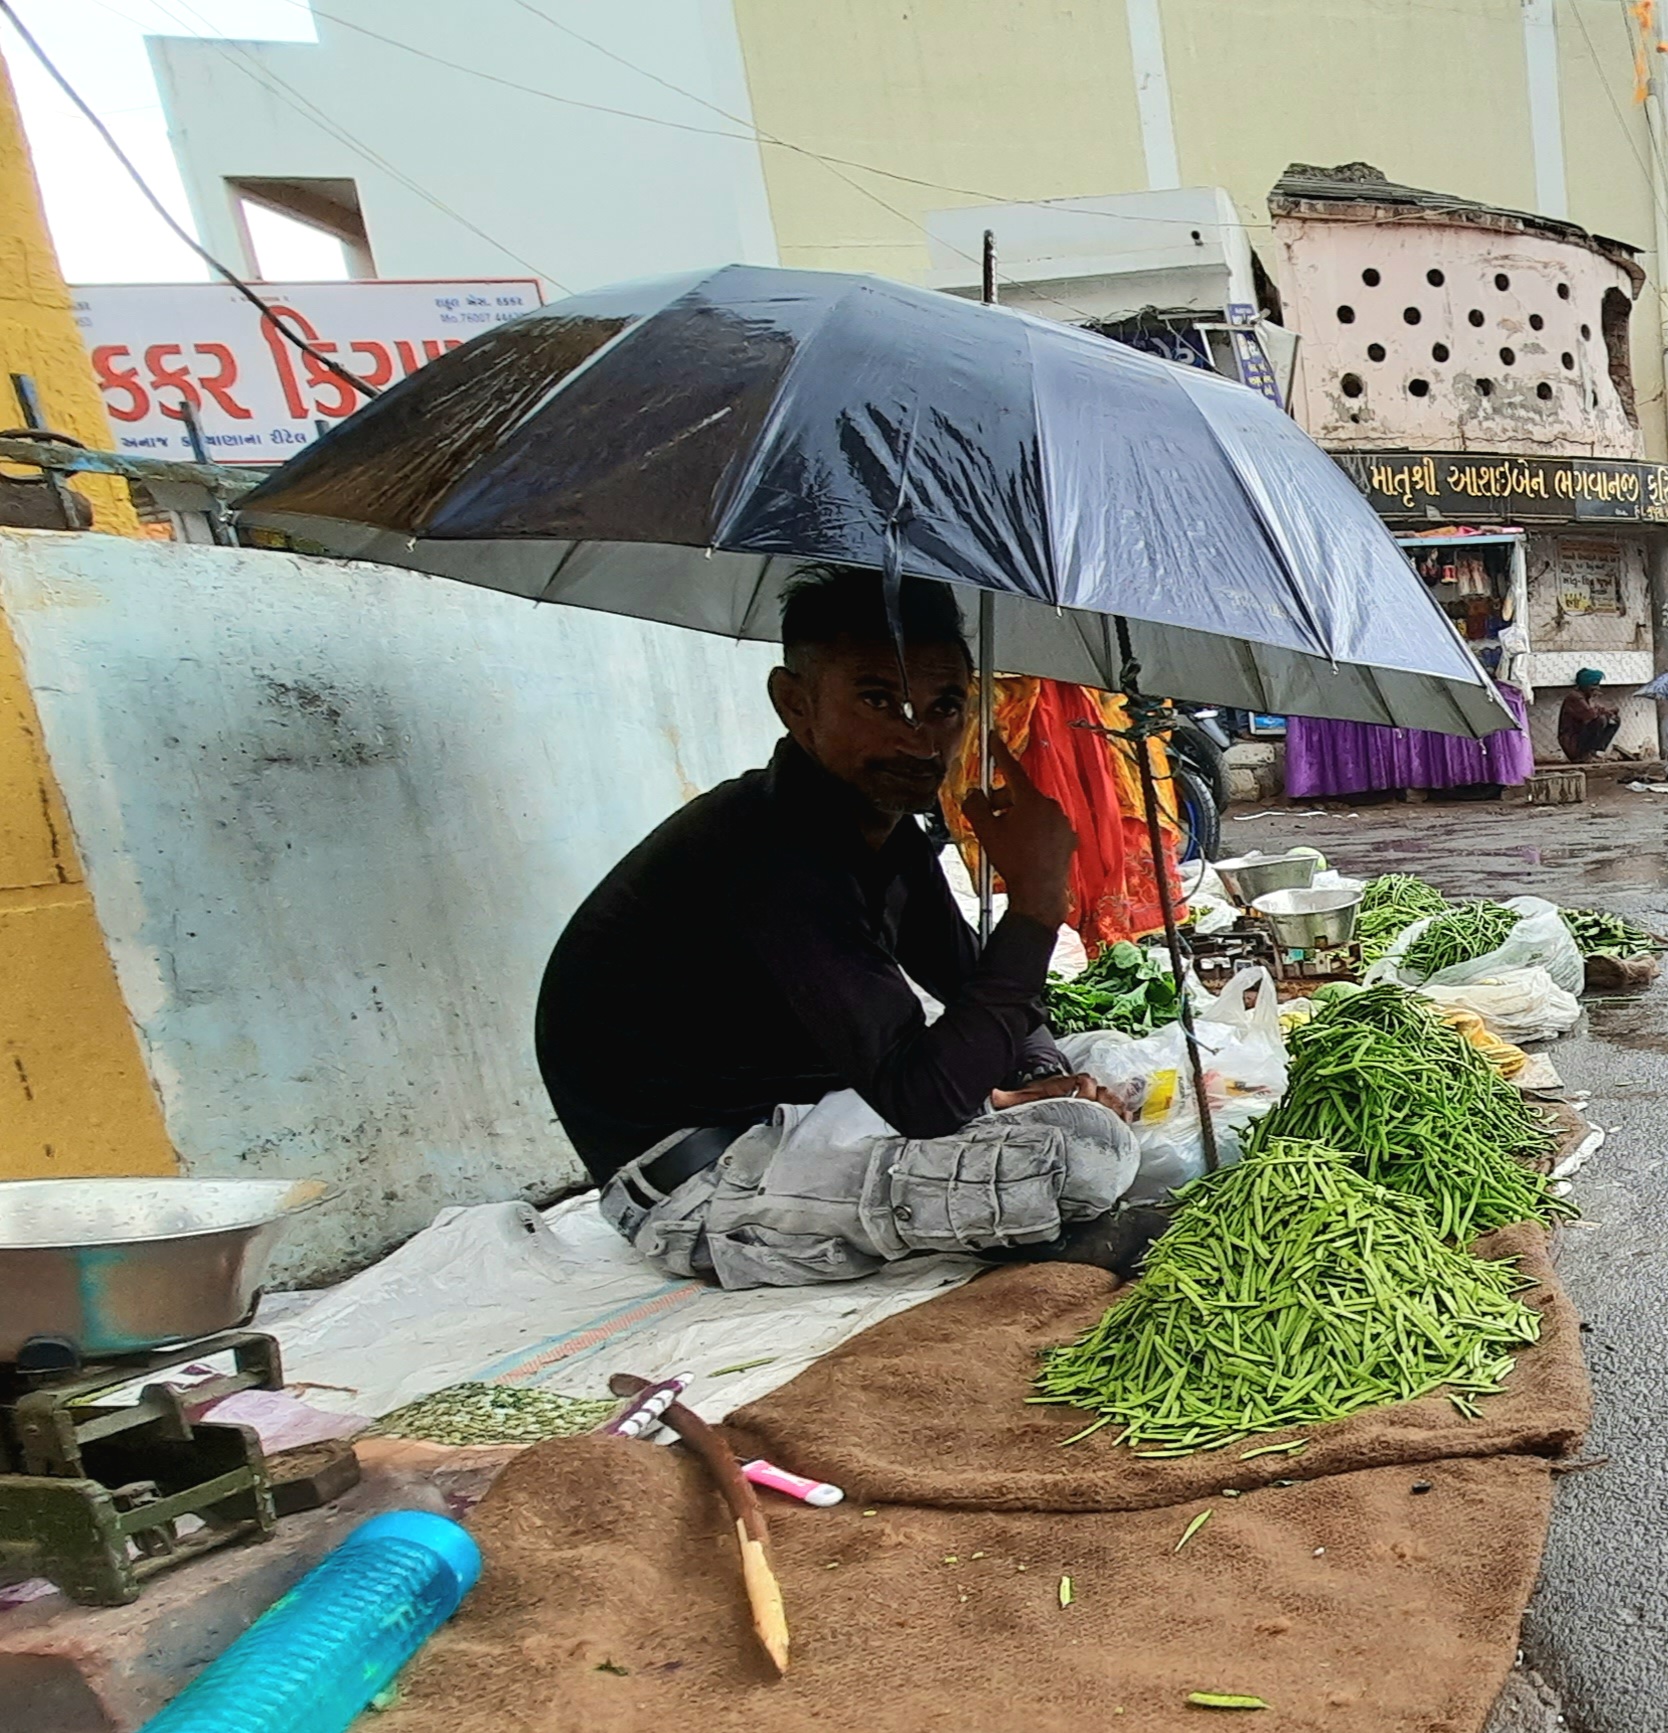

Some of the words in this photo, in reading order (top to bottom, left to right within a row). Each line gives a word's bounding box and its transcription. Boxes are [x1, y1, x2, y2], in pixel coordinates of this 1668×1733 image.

[92, 343, 253, 422] કકર
[1371, 457, 1440, 508] માતૃશ્રી
[1554, 469, 1639, 502] ભગવાનજી
